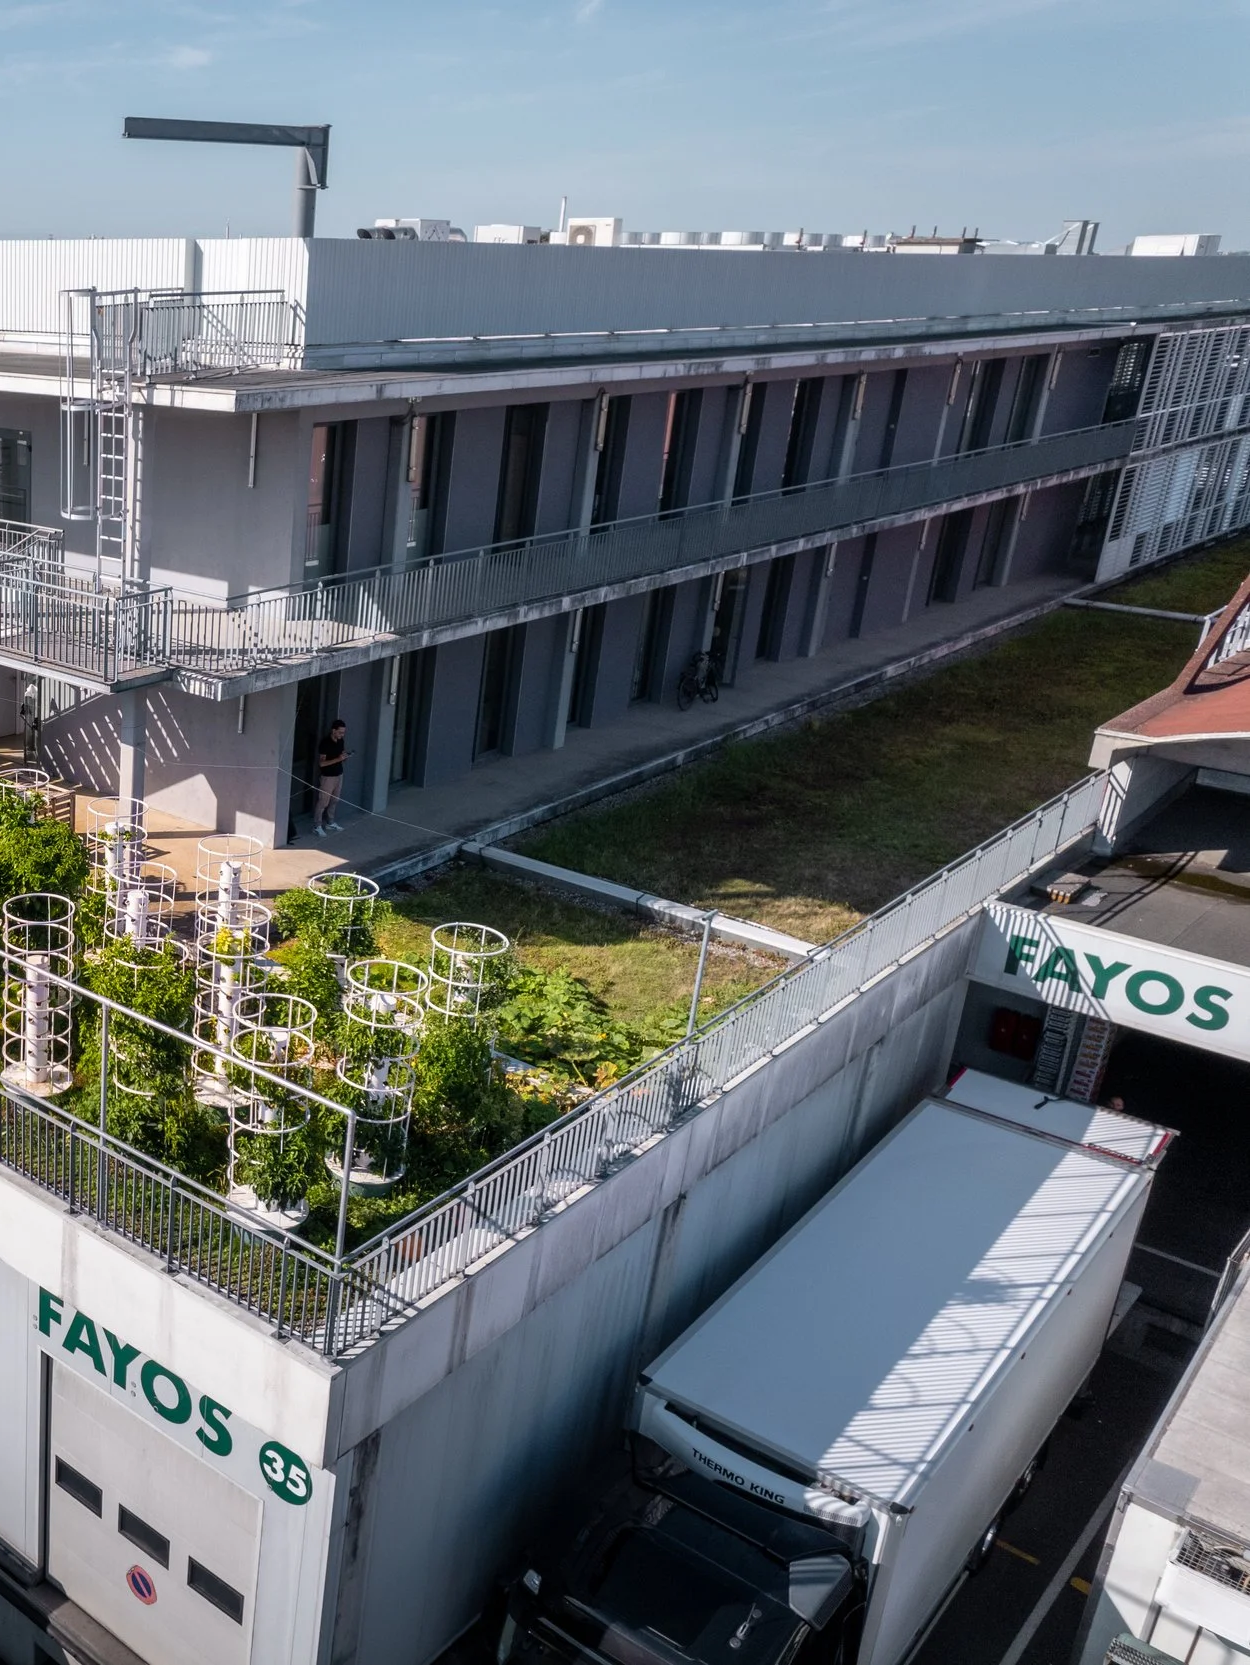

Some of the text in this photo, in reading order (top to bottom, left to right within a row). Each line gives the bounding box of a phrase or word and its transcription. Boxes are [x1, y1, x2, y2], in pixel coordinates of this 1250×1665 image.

[1003, 934, 1234, 1031] FAYOS
[38, 1286, 307, 1498] FAYOS 35
[691, 1447, 786, 1505] THERMO KING
